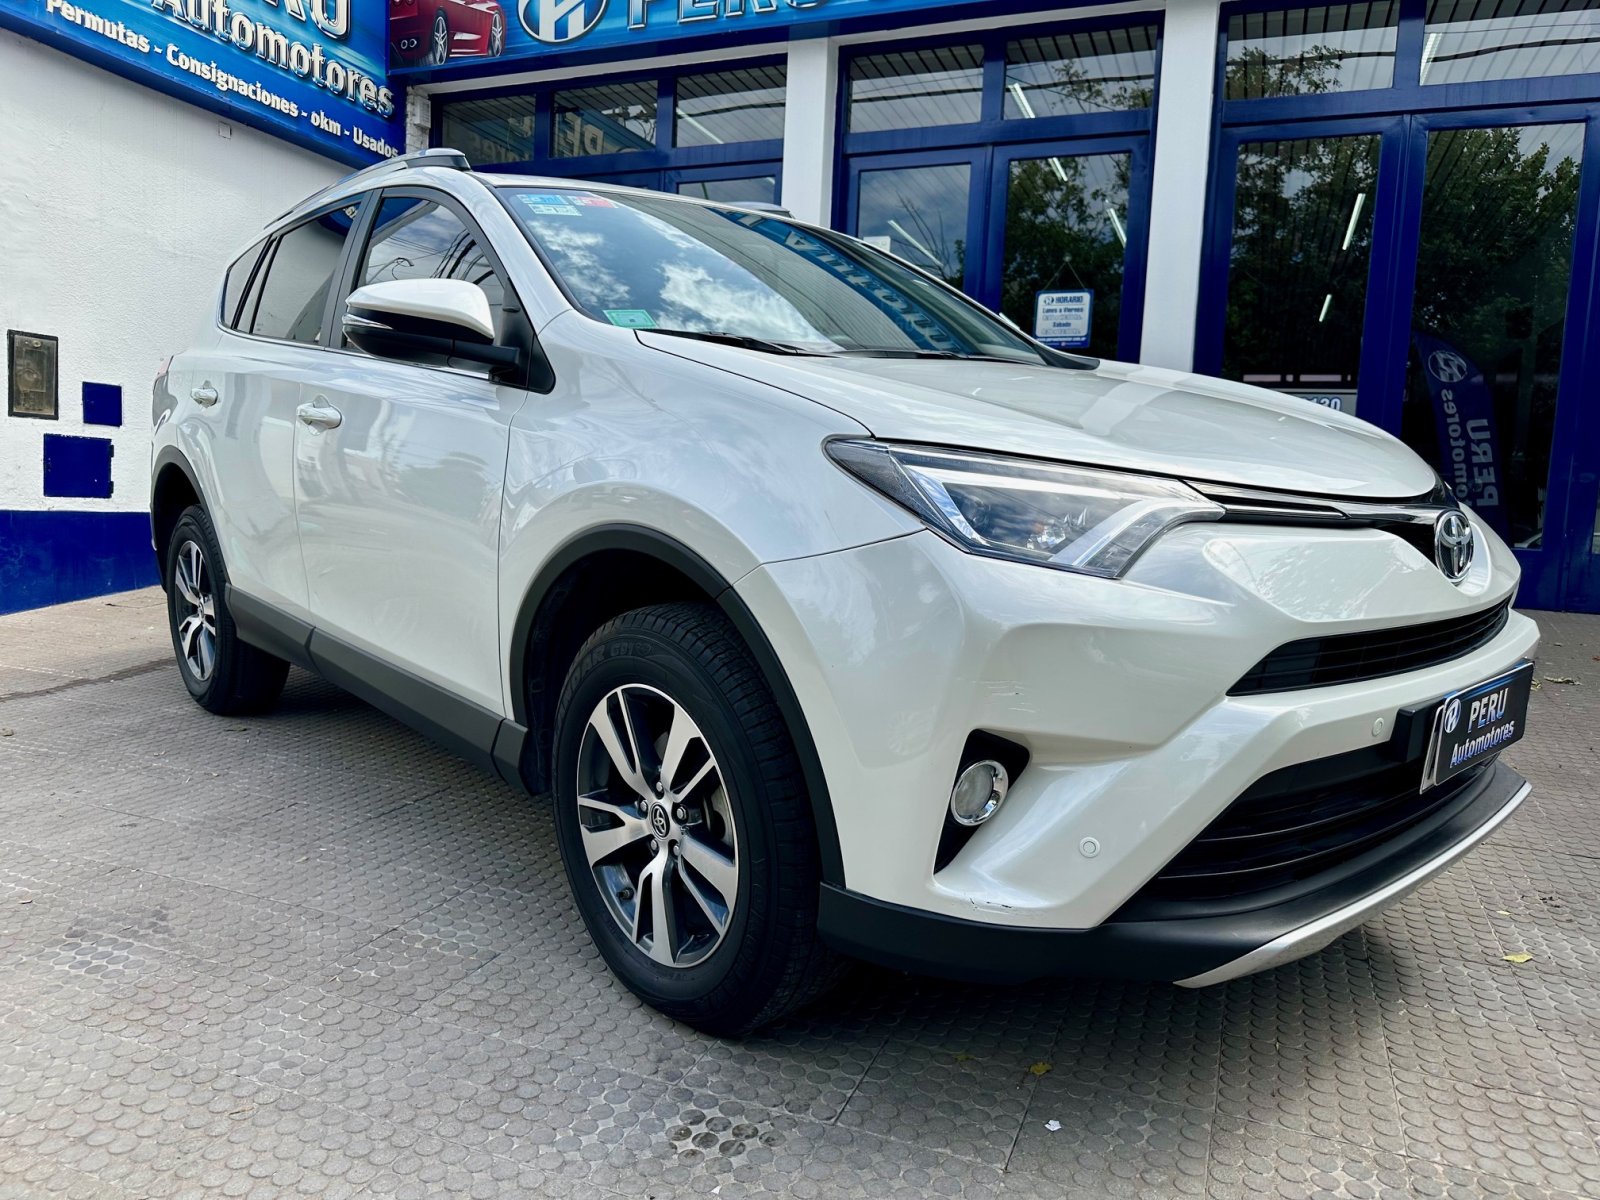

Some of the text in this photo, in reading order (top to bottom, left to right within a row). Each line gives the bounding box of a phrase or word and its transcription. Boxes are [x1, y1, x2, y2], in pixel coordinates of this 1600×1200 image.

[46, 0, 150, 53] Permutas
[166, 43, 299, 118] Consignaciones
[353, 125, 399, 158] Usados
[1467, 687, 1509, 734] PERU
[1449, 720, 1515, 769] Automotores
